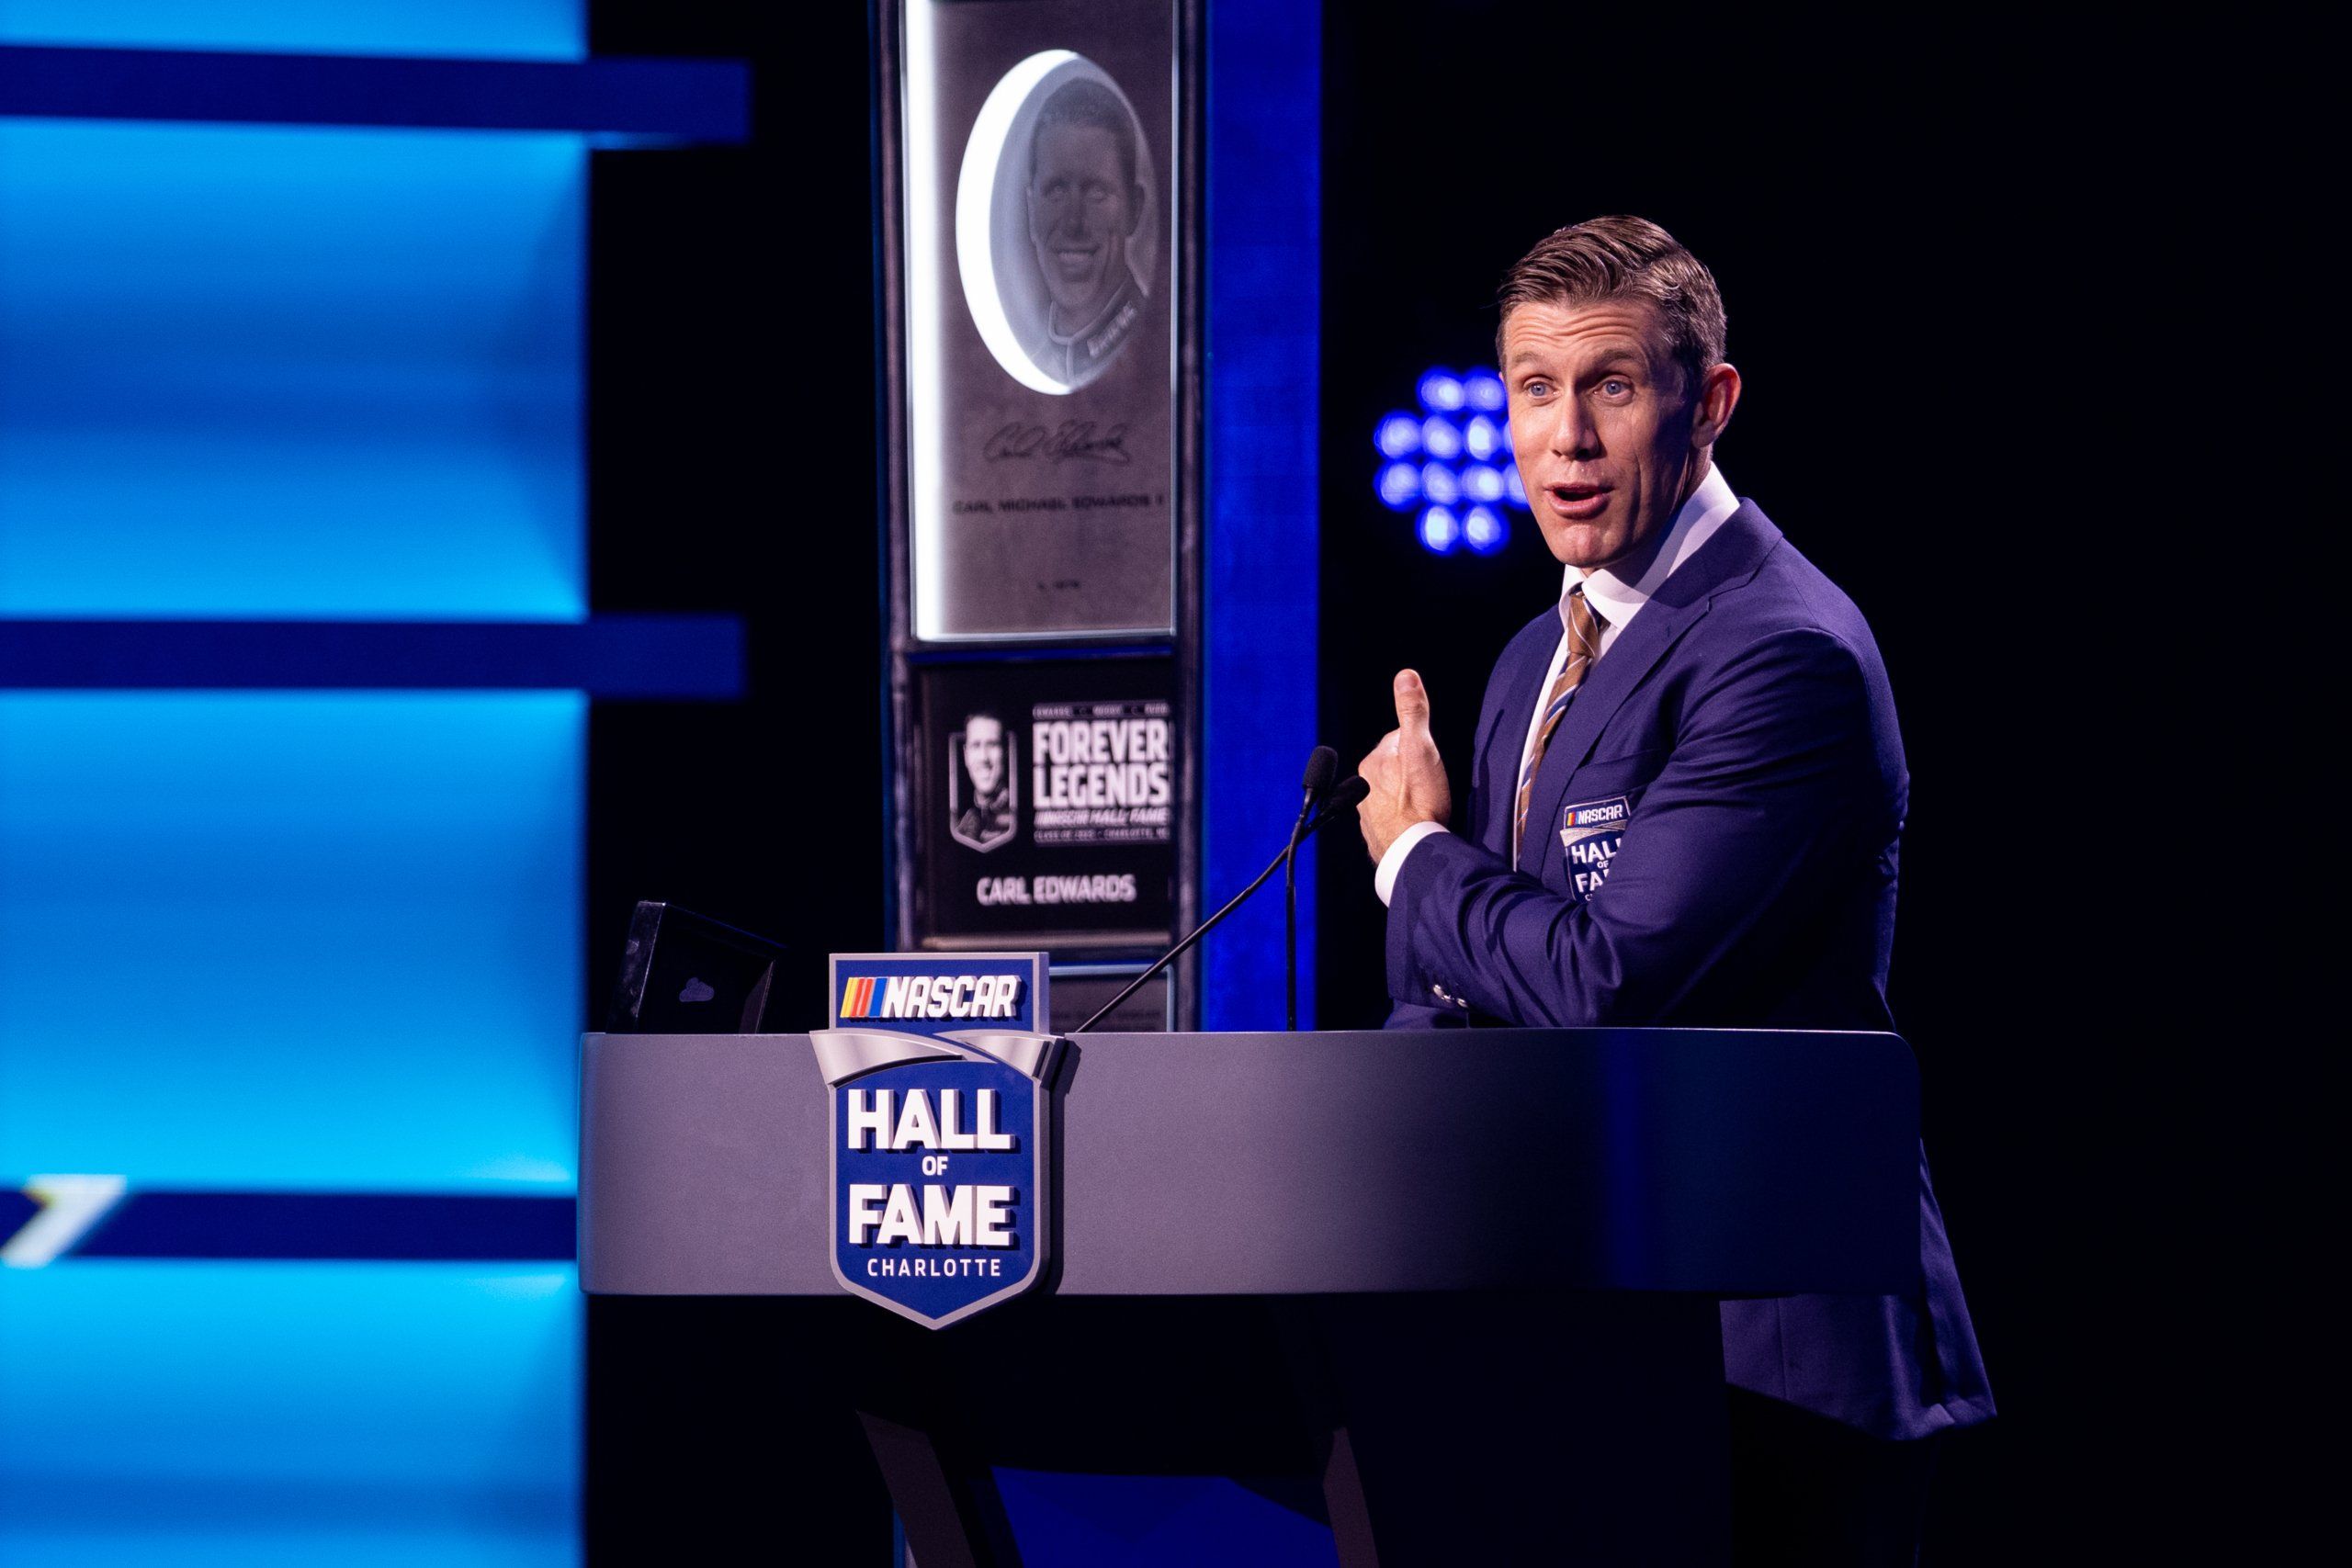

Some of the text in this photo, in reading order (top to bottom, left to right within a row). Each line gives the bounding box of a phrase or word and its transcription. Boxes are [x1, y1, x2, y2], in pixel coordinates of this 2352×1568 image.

[1033, 719, 1170, 764] FOREVER
[1033, 763, 1170, 809] LEGENDS
[1577, 805, 1623, 824] NASCAR
[1597, 860, 1609, 869] OF
[977, 874, 1137, 906] CARL EDWARDS
[882, 975, 1023, 1019] NASCAR
[847, 1089, 1016, 1150] HALL
[922, 1155, 948, 1176] OF
[848, 1183, 1015, 1247] FAME
[867, 1258, 1001, 1278] CHARLOTTE
